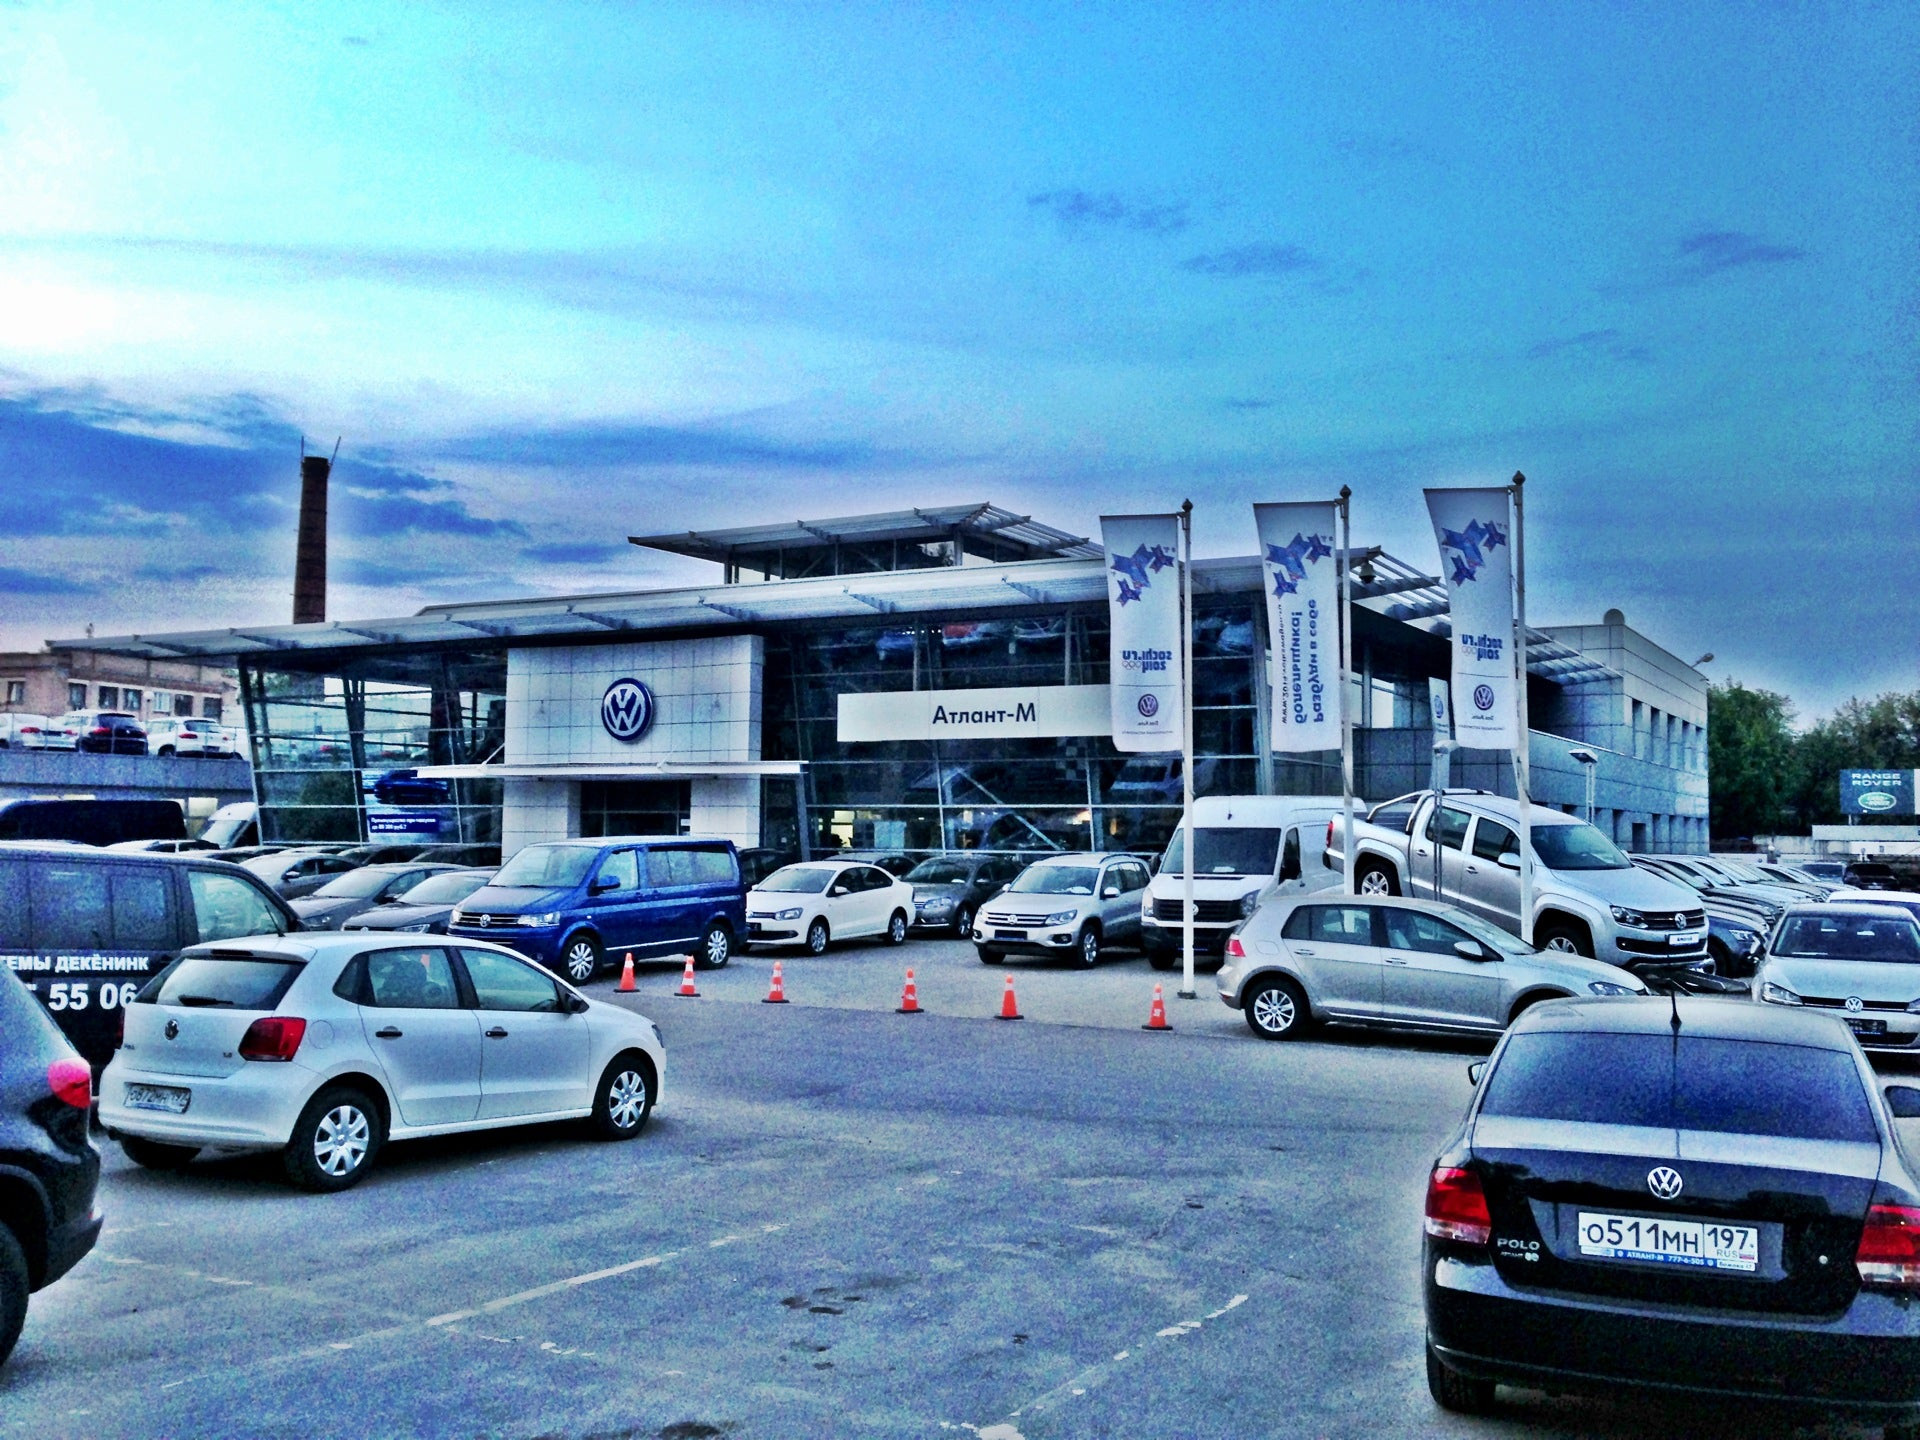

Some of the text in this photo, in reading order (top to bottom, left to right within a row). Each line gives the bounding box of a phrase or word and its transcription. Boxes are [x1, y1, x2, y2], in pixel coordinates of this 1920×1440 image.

[932, 702, 1036, 724] Атлант-М
[55, 954, 149, 973] ДЕКЁНИНК
[48, 983, 138, 1010] 55 06
[1497, 1238, 1540, 1250] POLO
[1707, 1227, 1749, 1250] 197
[1716, 1249, 1738, 1258] RUS
